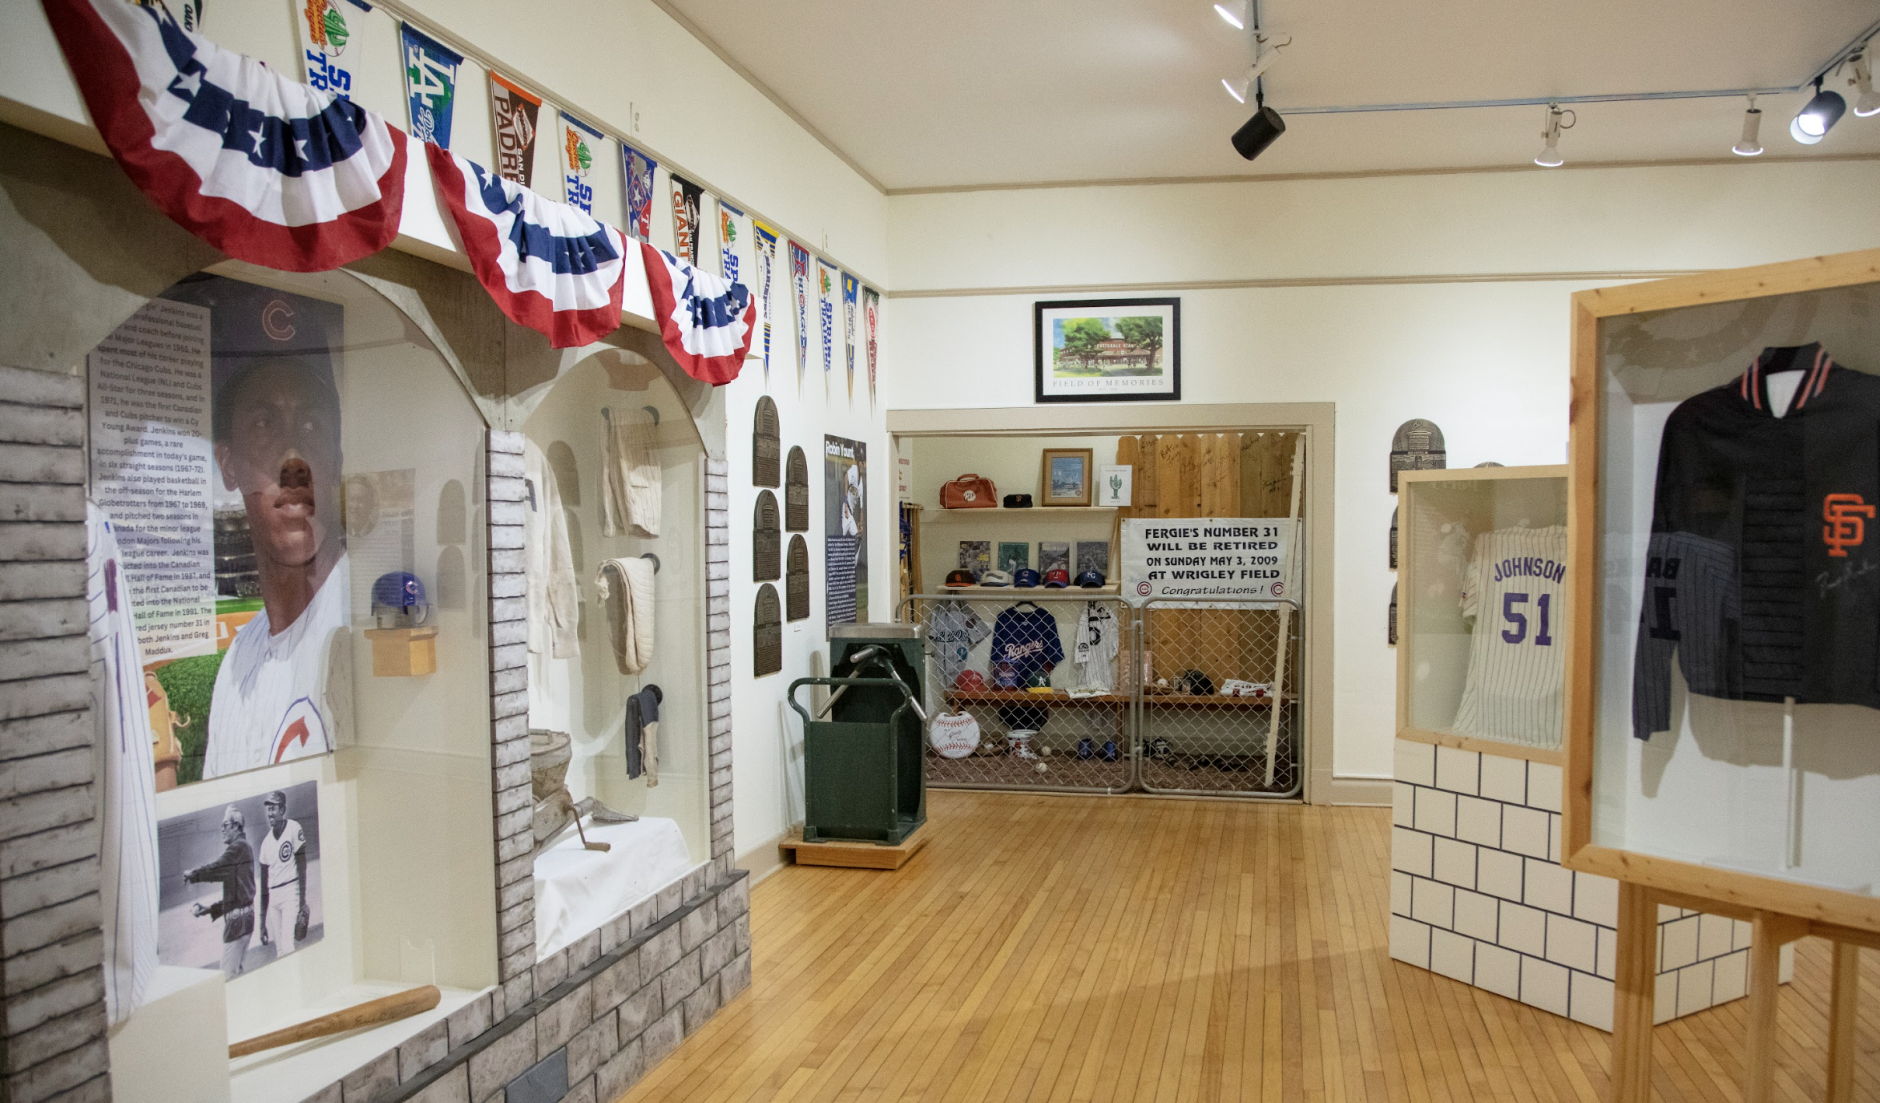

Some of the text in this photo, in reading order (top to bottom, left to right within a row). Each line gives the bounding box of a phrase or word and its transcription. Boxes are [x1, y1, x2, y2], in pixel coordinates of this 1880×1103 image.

[408, 46, 455, 108] LA
[494, 97, 520, 182] PADRE
[674, 191, 690, 261] GIANT
[133, 313, 175, 326] professional
[115, 333, 164, 348] Major Leagues
[139, 328, 158, 336] coach
[160, 330, 181, 340] before
[182, 333, 204, 346] joining
[98, 346, 118, 354] spent
[147, 351, 157, 360] his
[159, 354, 180, 363] career
[181, 356, 204, 368] playing
[100, 357, 113, 366] for
[112, 359, 124, 368] the
[126, 361, 154, 373] Chicago
[154, 365, 172, 374] Cubs.
[100, 370, 131, 381] National
[132, 374, 156, 385] League
[157, 377, 171, 387] (NL)
[186, 381, 202, 390] Cubs
[97, 382, 124, 392] All-Star
[125, 386, 136, 394] for
[137, 387, 155, 396] three
[157, 391, 183, 401] seasons,
[100, 396, 119, 406] 1971,
[145, 401, 156, 409] the
[158, 402, 171, 410] first
[172, 403, 202, 414] Canadian
[120, 411, 138, 420] Cubs
[139, 413, 163, 422] pitcher
[102, 422, 124, 433] Young
[126, 424, 149, 433] Award.
[150, 426, 175, 435] Jenkins
[124, 436, 138, 445] plus
[140, 439, 163, 448] games,
[826, 440, 840, 456] Robin
[97, 449, 155, 458] accomplishment
[119, 461, 146, 471] straight
[98, 473, 126, 481] Jenkins
[143, 475, 165, 484] played
[166, 476, 200, 484] basketball
[118, 487, 154, 495] off-season
[99, 499, 147, 507] Globetrotters
[190, 501, 208, 509] 1969,
[125, 512, 151, 521] pitched
[180, 525, 201, 534] league
[1824, 494, 1876, 557] SF
[1146, 527, 1278, 540] FERGIE'S NUMBER 31
[137, 537, 159, 546] Majors
[160, 536, 191, 545] following
[1146, 542, 1278, 551] WILL BE RETIRED
[122, 550, 144, 558] league
[1146, 556, 1278, 566] ON SUNDAY MAY 3, 2009
[181, 572, 198, 580] 1987,
[1148, 570, 1280, 580] AT WRIGLEY FIELD
[1494, 557, 1566, 584] JOHNSON
[161, 585, 191, 593] Canadian
[406, 580, 418, 594] C
[173, 595, 200, 604] National
[182, 608, 199, 616] 1991.
[1502, 592, 1552, 646] 51
[148, 623, 168, 632] jersey
[170, 620, 194, 629] number
[138, 632, 209, 644] both Jenkins and Greg
[145, 647, 173, 655] Maddux.
[1004, 640, 1044, 659] Rangers
